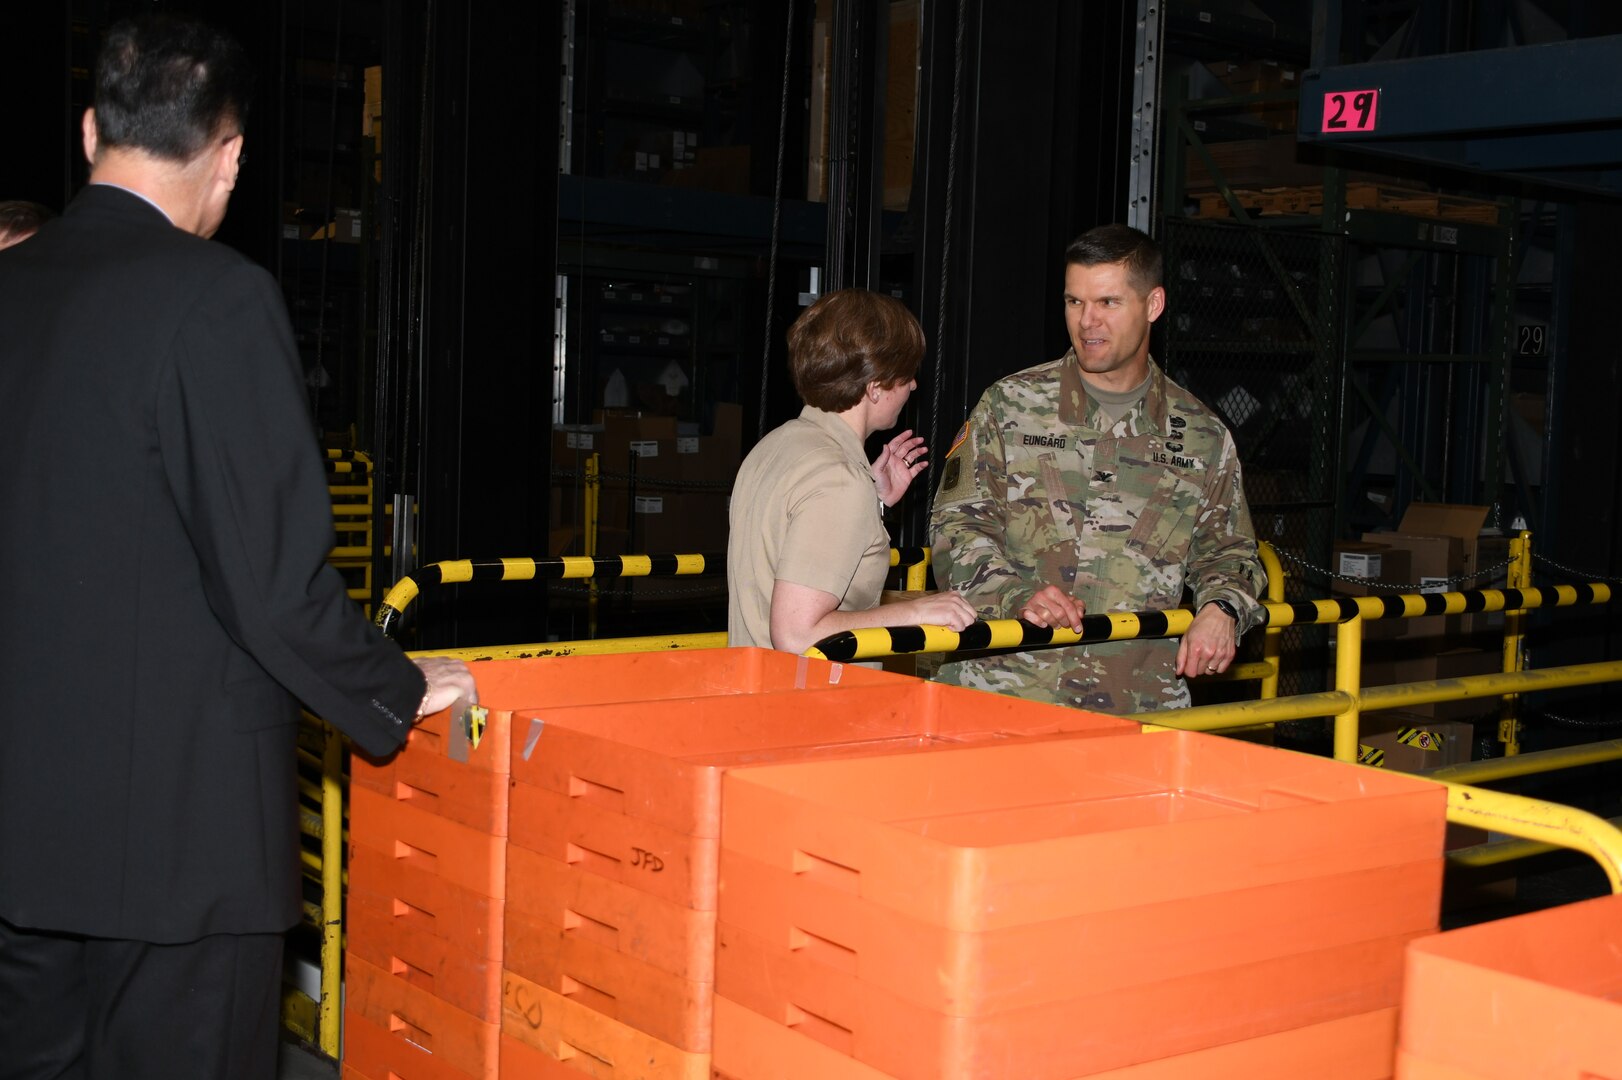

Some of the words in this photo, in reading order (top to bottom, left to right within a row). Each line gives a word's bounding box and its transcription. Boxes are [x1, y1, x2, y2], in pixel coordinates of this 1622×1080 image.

[1327, 92, 1374, 129] 29
[1520, 326, 1543, 355] 29
[1022, 434, 1067, 449] EUNGARD
[1152, 452, 1169, 464] U.S.
[1170, 455, 1196, 469] ARMY
[631, 846, 665, 872] JFD
